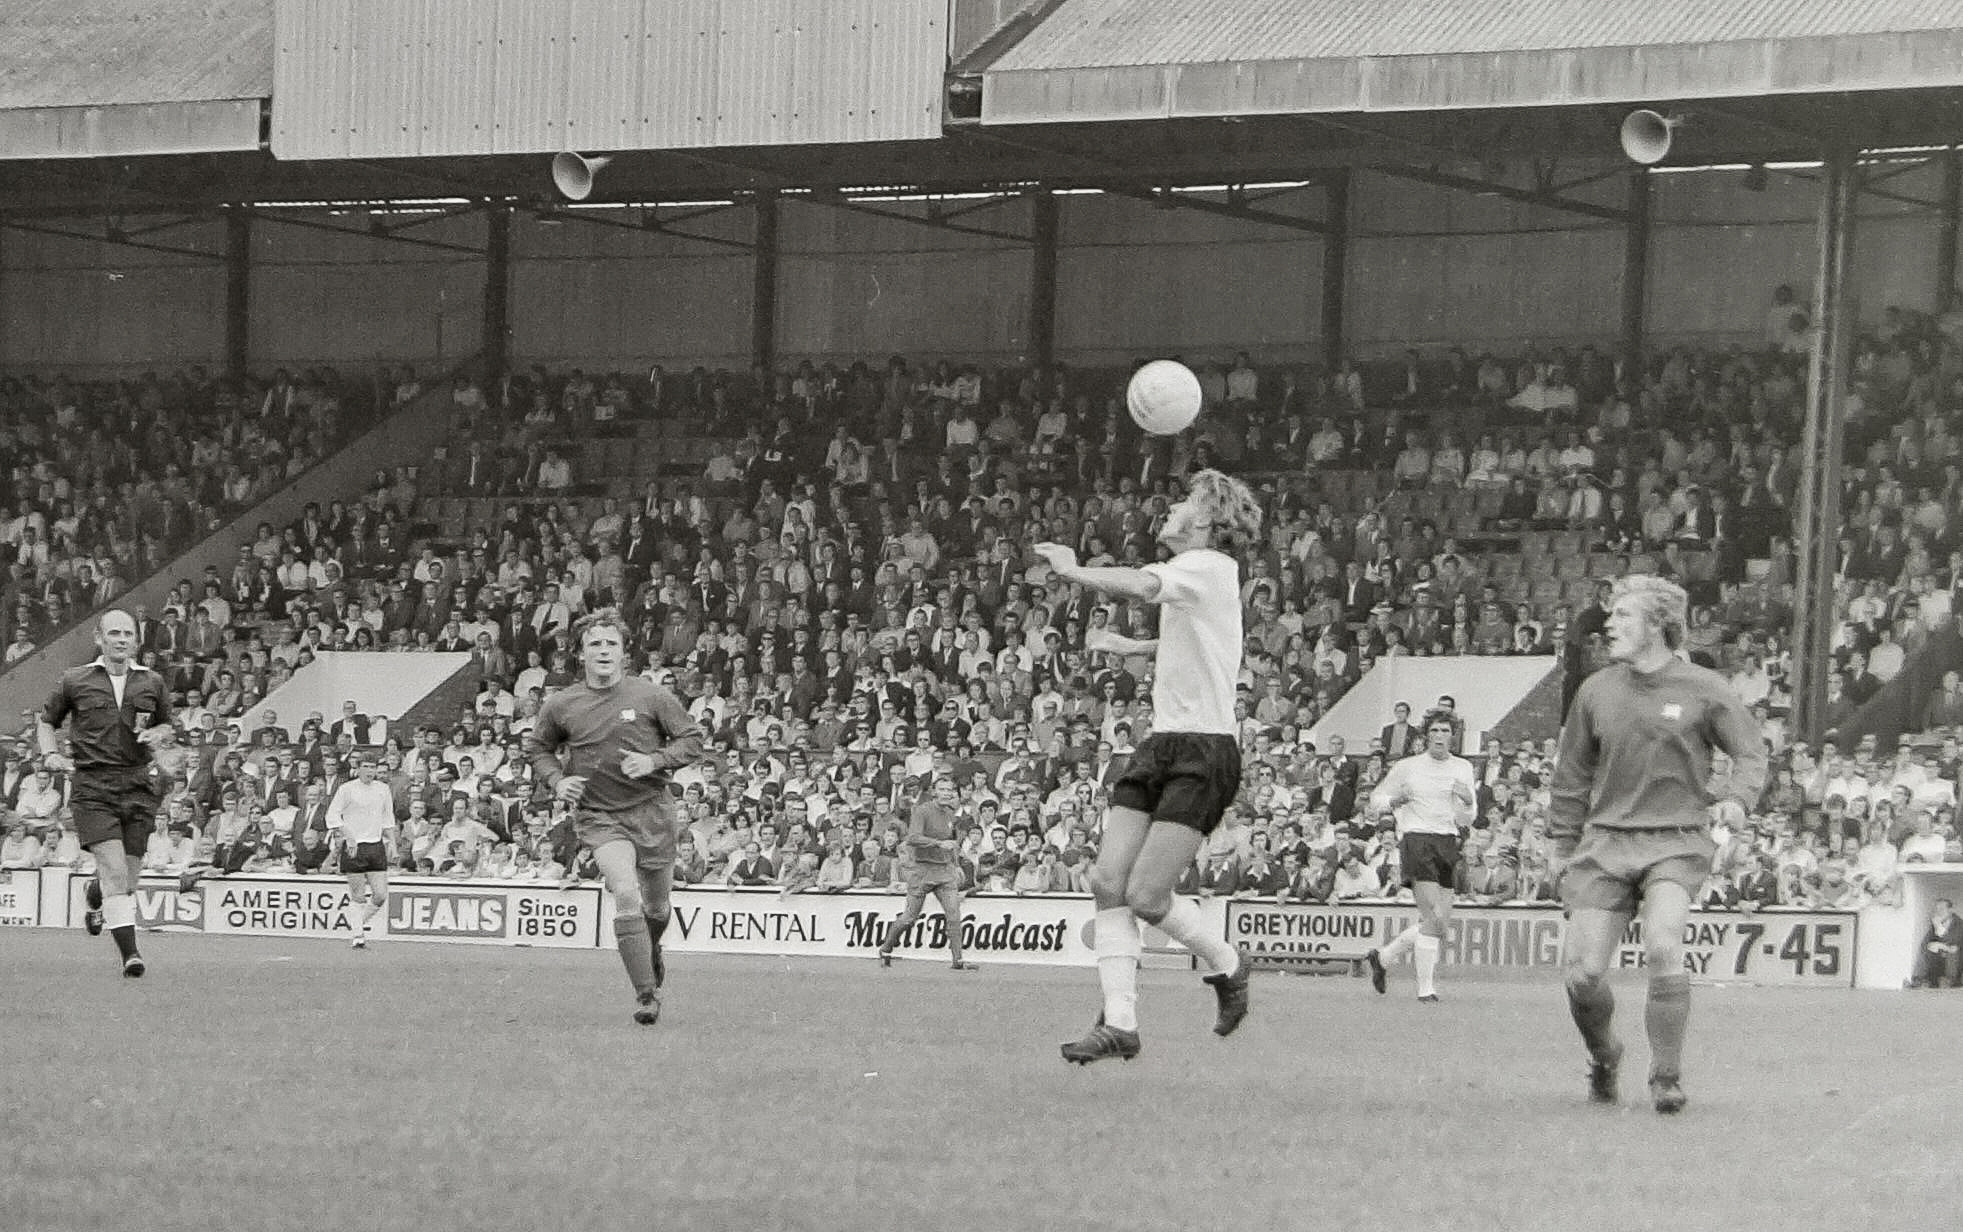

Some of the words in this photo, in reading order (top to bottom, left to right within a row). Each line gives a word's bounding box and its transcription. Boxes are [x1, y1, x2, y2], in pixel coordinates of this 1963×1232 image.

[221, 890, 371, 911] AMERICA
[518, 898, 578, 917] Since
[229, 910, 371, 931] ORIGINA
[390, 896, 503, 932] JEANS
[1238, 912, 1375, 938] GREYHOUND
[517, 917, 577, 938] 1850
[710, 911, 825, 942] RENTAL
[844, 911, 1067, 951] MutiBoadcast
[1621, 921, 1730, 946] MDAY
[1620, 950, 1713, 974] FRAY
